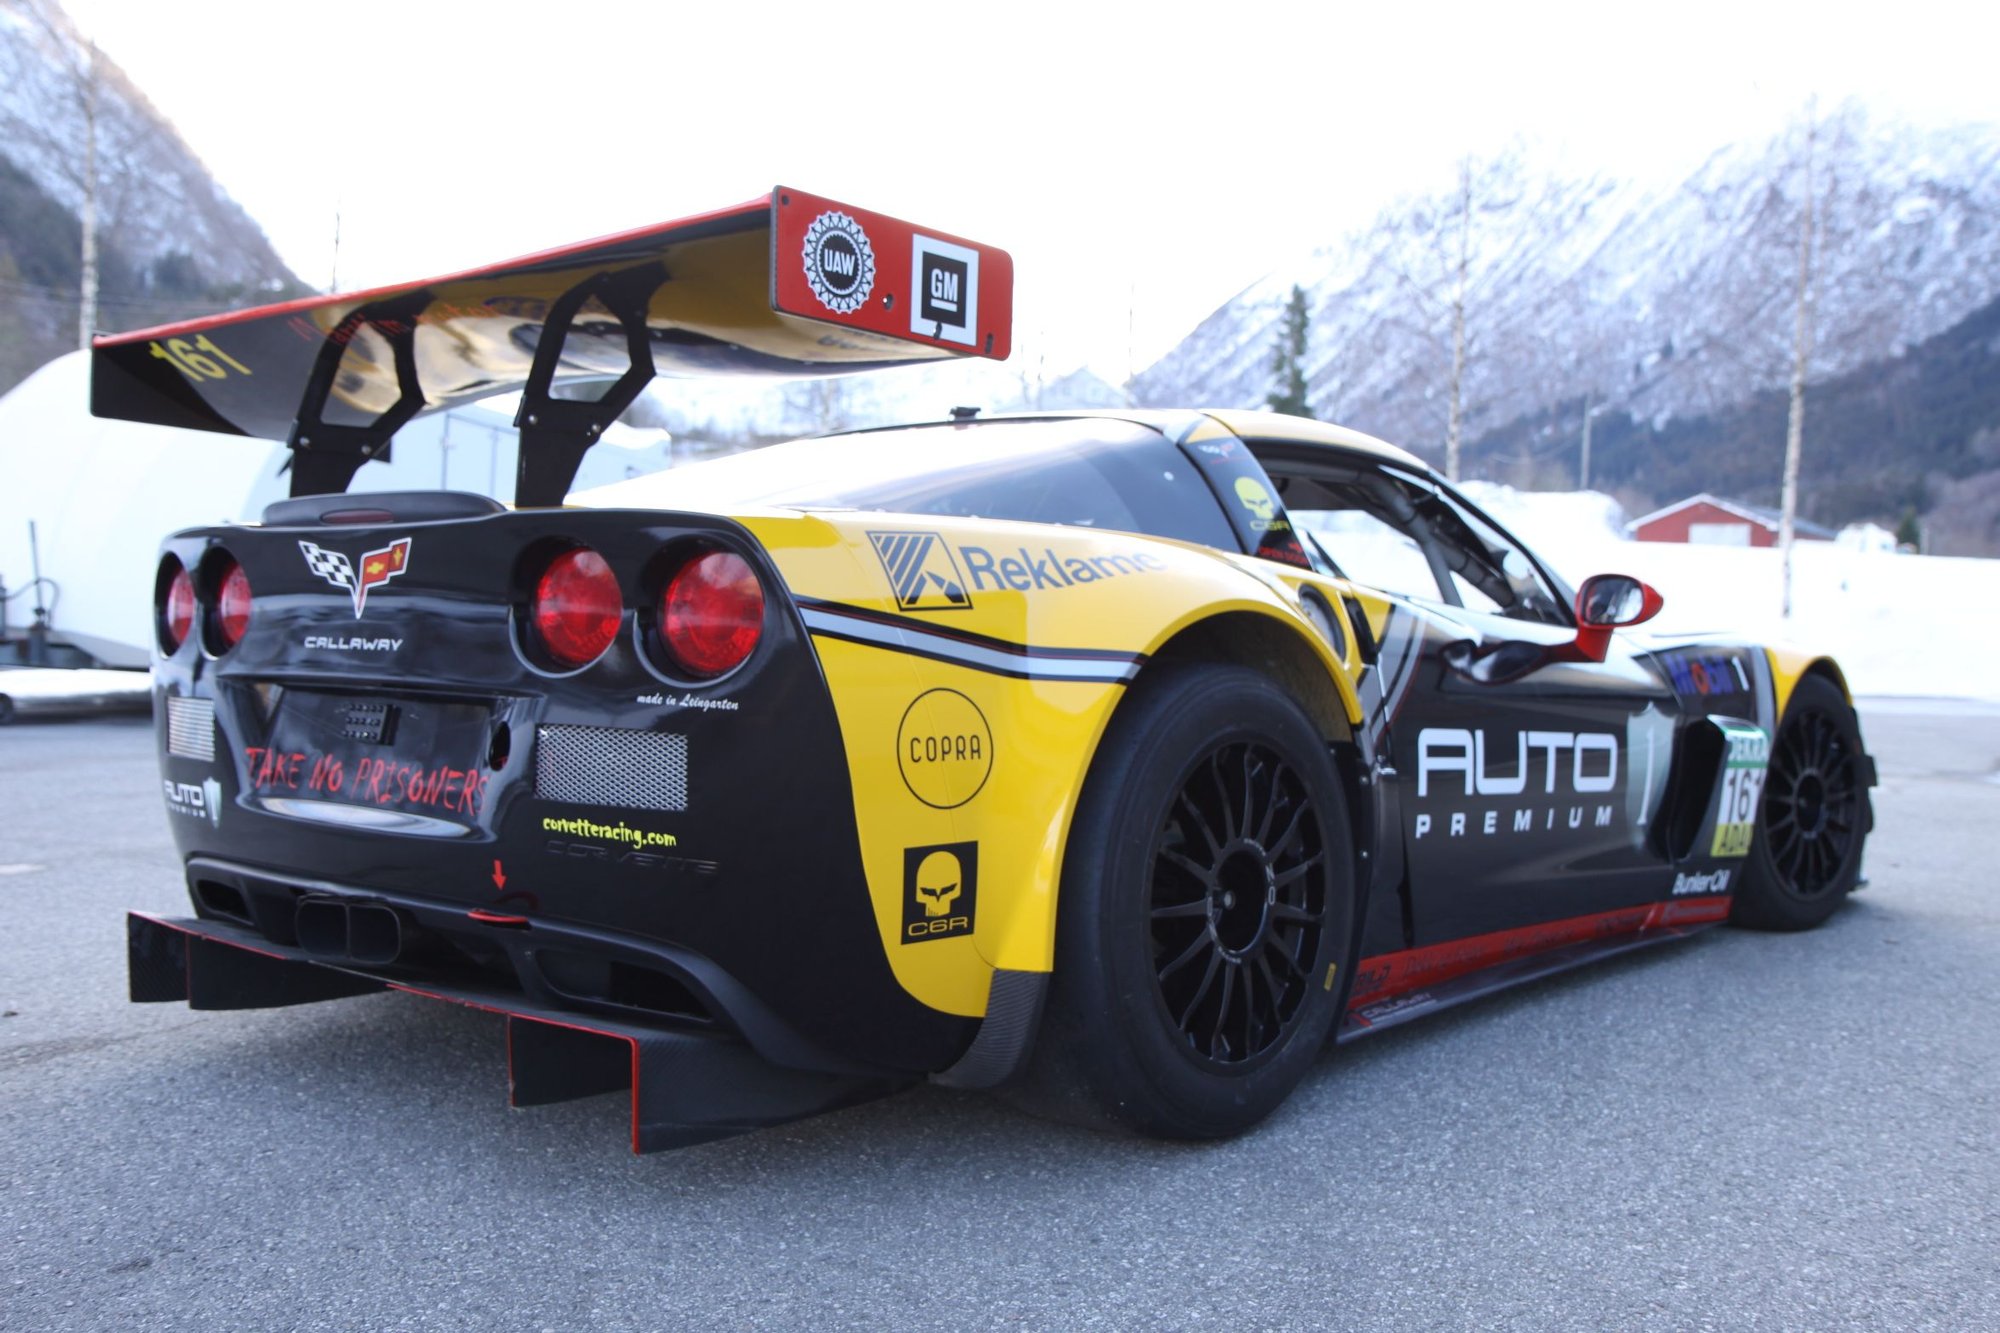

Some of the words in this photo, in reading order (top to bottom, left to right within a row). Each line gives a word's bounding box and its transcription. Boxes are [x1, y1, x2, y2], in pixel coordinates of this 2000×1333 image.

[824, 249, 855, 276] UAW
[931, 268, 958, 302] GM
[150, 334, 252, 382] 161
[304, 636, 403, 651] CALLAWAY
[636, 692, 662, 706] made
[666, 693, 676, 706] in
[679, 694, 739, 712] Leingarten
[910, 734, 981, 763] COPRA
[1417, 728, 1618, 797] AUTO
[245, 747, 306, 789] TAKE
[309, 754, 343, 792] NO
[354, 757, 491, 816] PRISONERS
[543, 817, 677, 849] corvetteracing.com
[1415, 805, 1613, 839] PREMIUM
[908, 916, 968, 937] C6R
